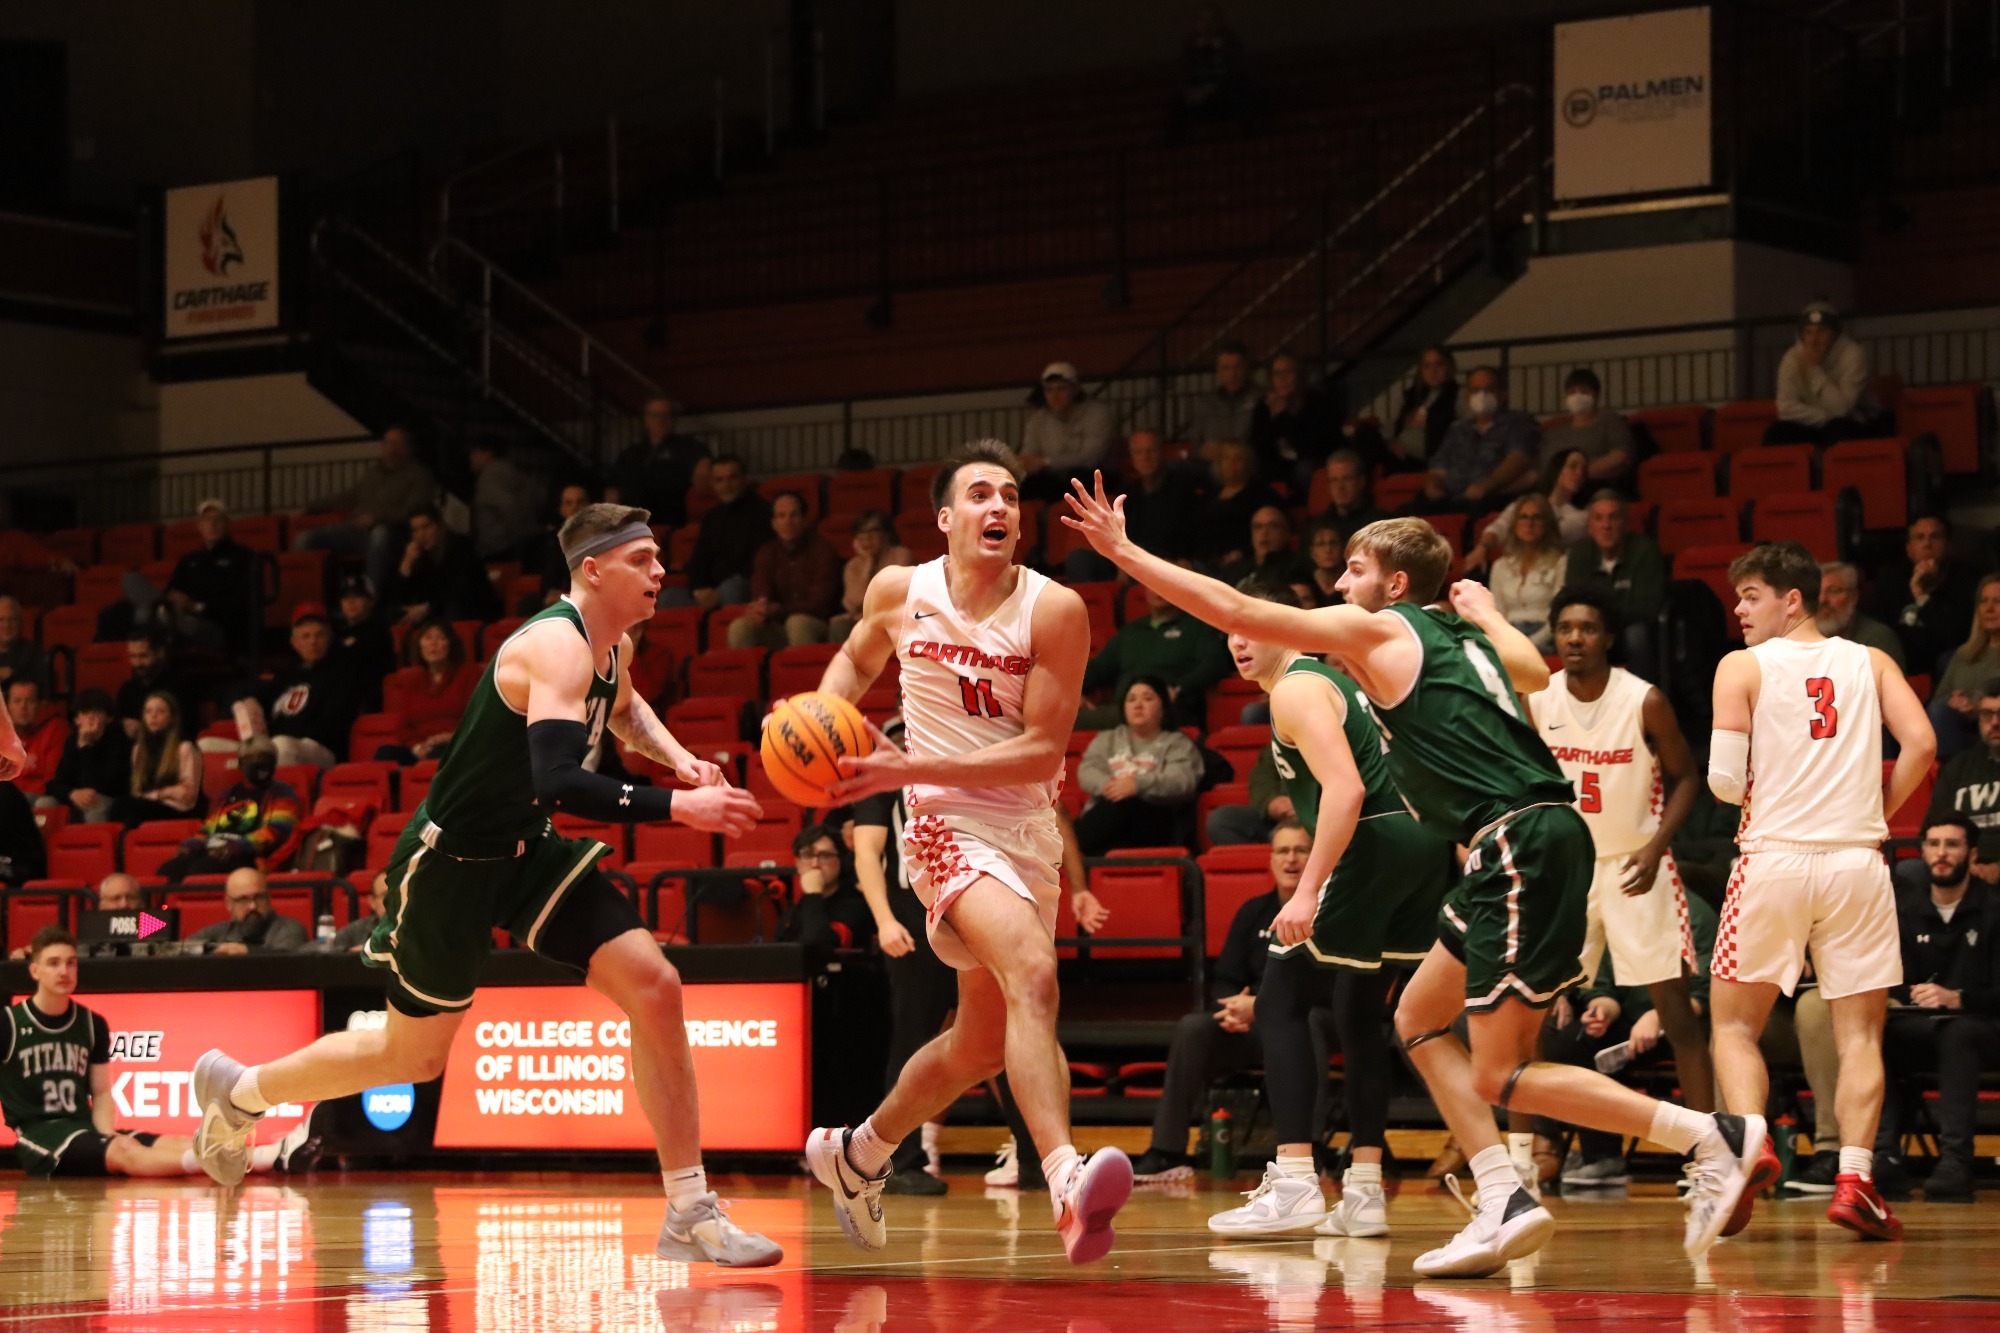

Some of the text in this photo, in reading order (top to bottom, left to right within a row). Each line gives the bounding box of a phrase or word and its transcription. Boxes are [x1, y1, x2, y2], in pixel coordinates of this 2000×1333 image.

[1597, 75, 1704, 101] PALMEN
[174, 280, 270, 310] CARTHAGE
[909, 640, 1031, 675] CARTHAGE
[958, 675, 1003, 718] 11
[1805, 676, 1838, 740] 3
[1579, 770, 1602, 813] 5
[475, 1020, 778, 1048] COLLEGE CORENCE
[19, 1041, 89, 1078] TITANS
[475, 1054, 512, 1081] OF
[517, 1054, 626, 1081] ILLINOIS
[42, 1079, 77, 1113] 20
[475, 1088, 624, 1116] WISCONSIN
